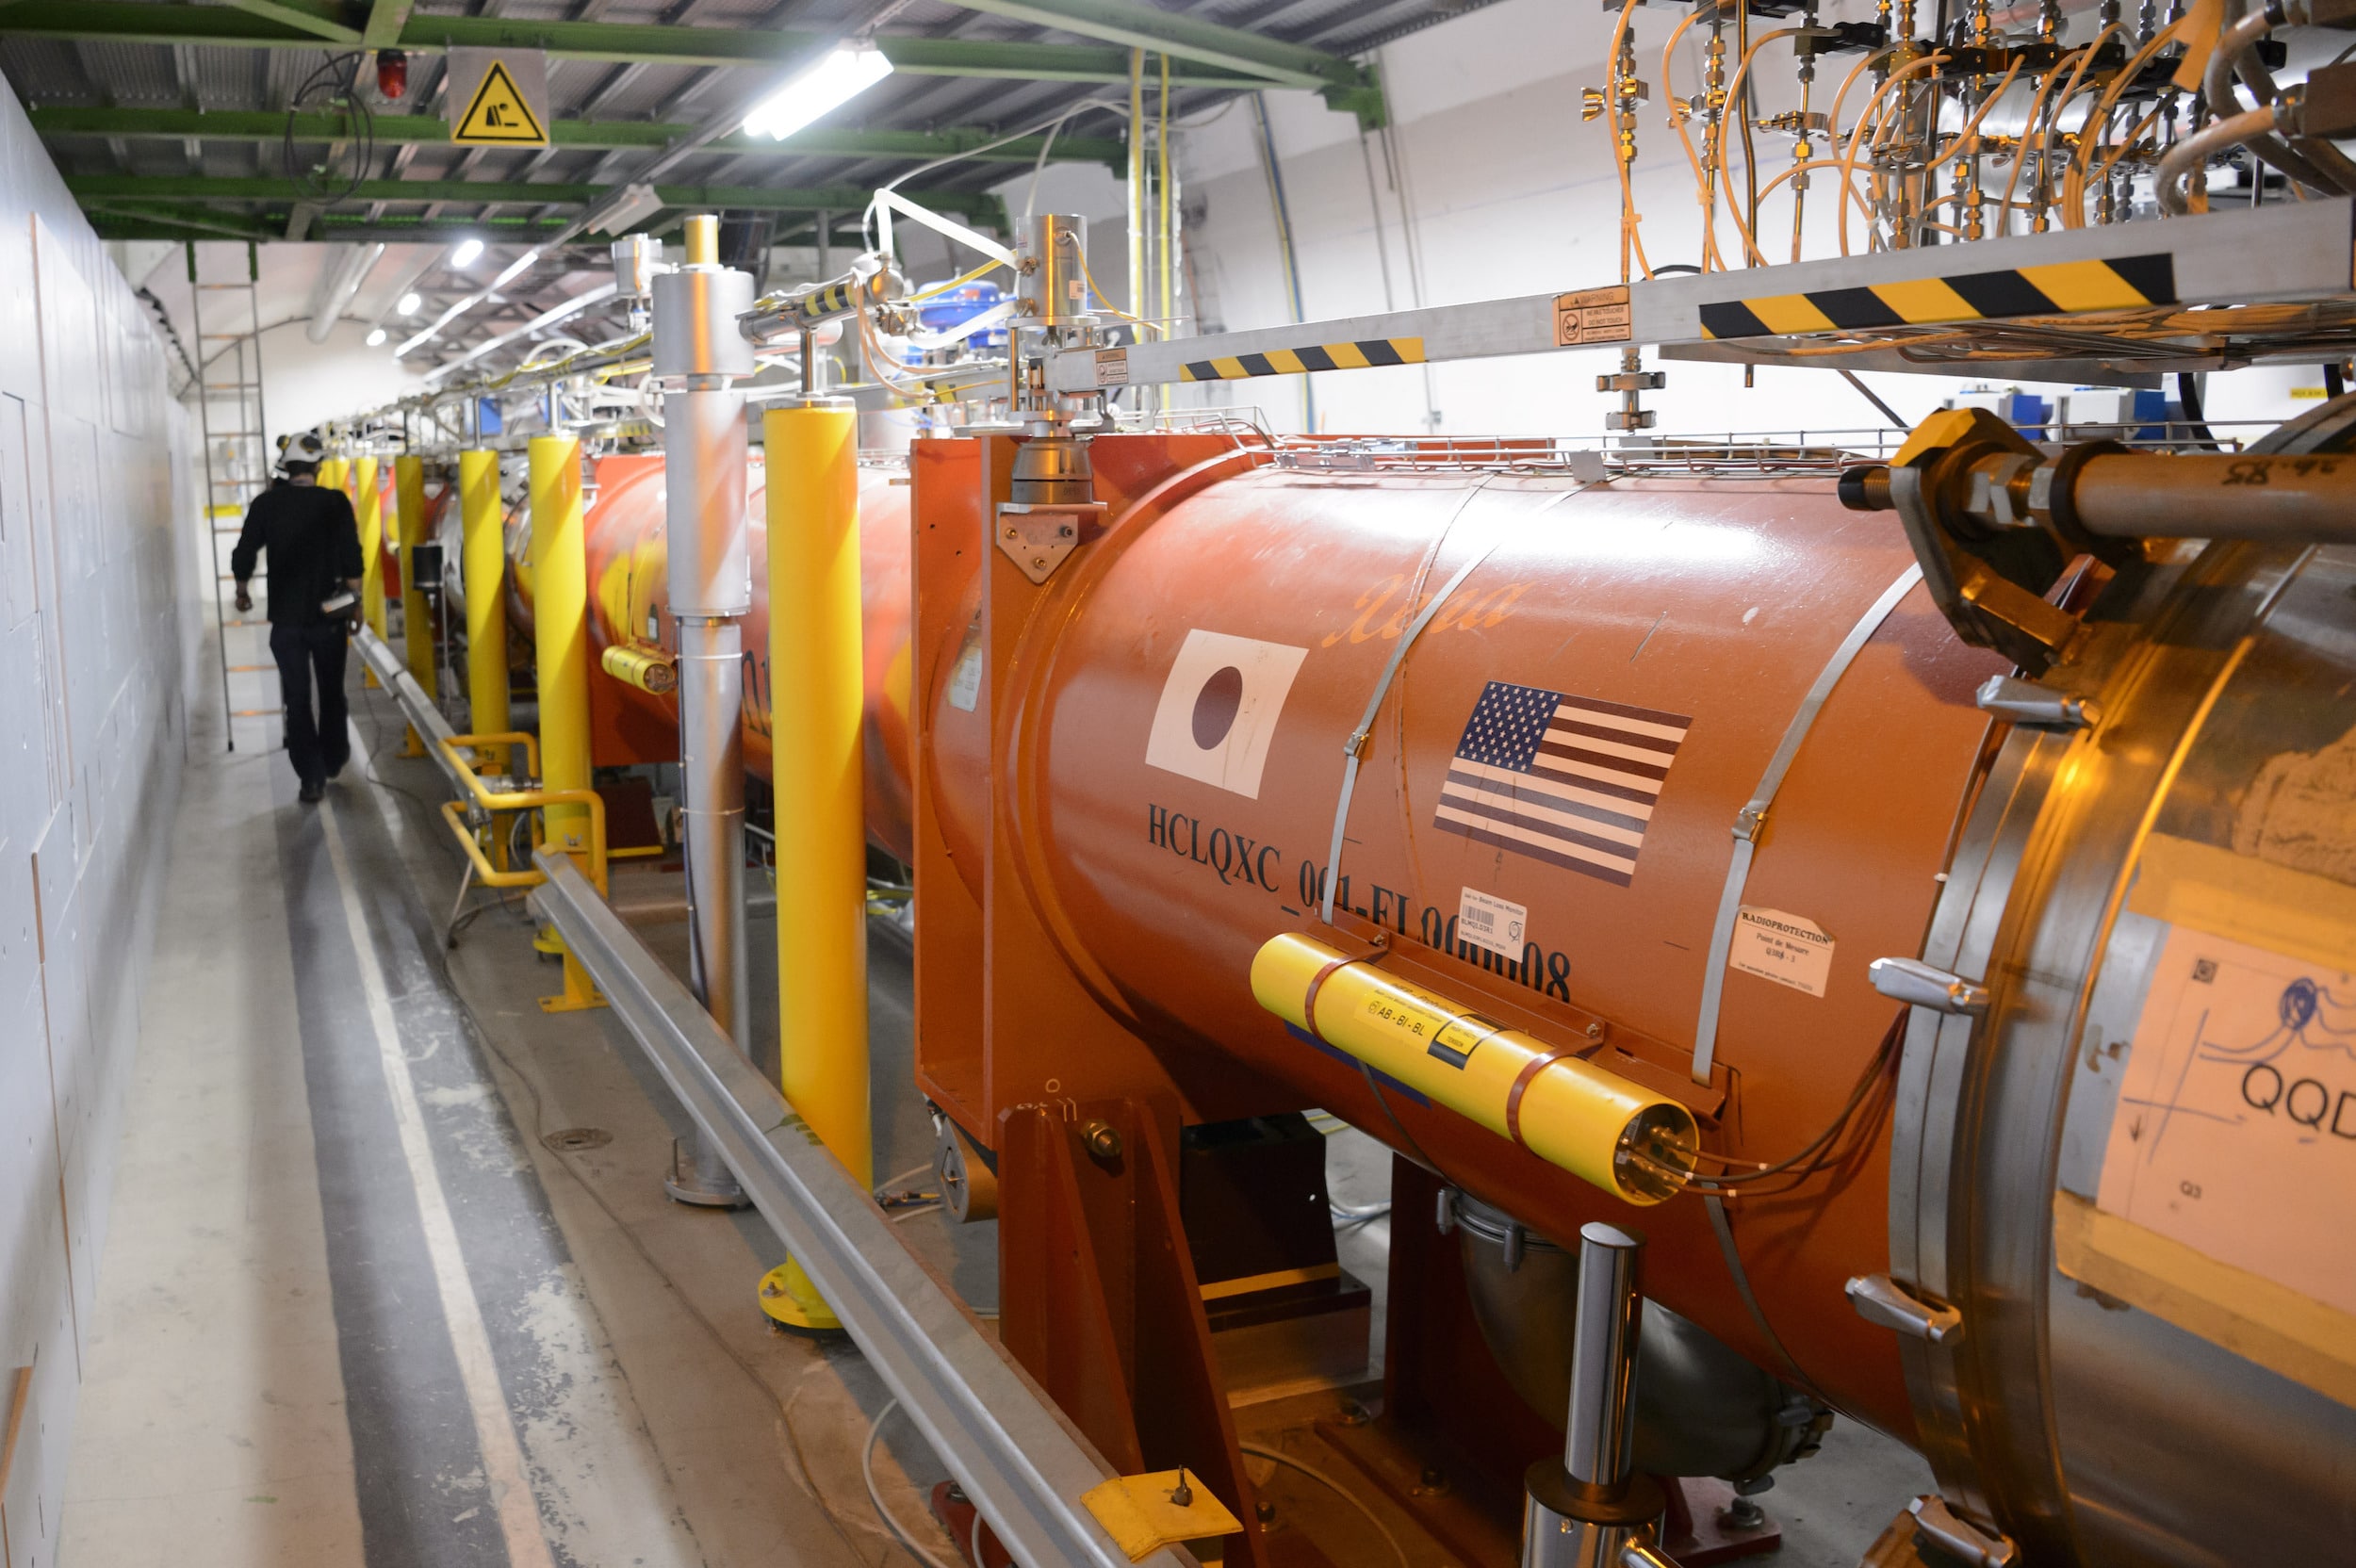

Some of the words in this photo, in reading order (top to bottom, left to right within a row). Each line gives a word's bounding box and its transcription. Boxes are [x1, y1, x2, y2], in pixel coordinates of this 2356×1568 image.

[1742, 911, 1829, 945] RADIOPROTECTION
[1377, 1006, 1393, 1020] AB
[1412, 1022, 1425, 1037] BL
